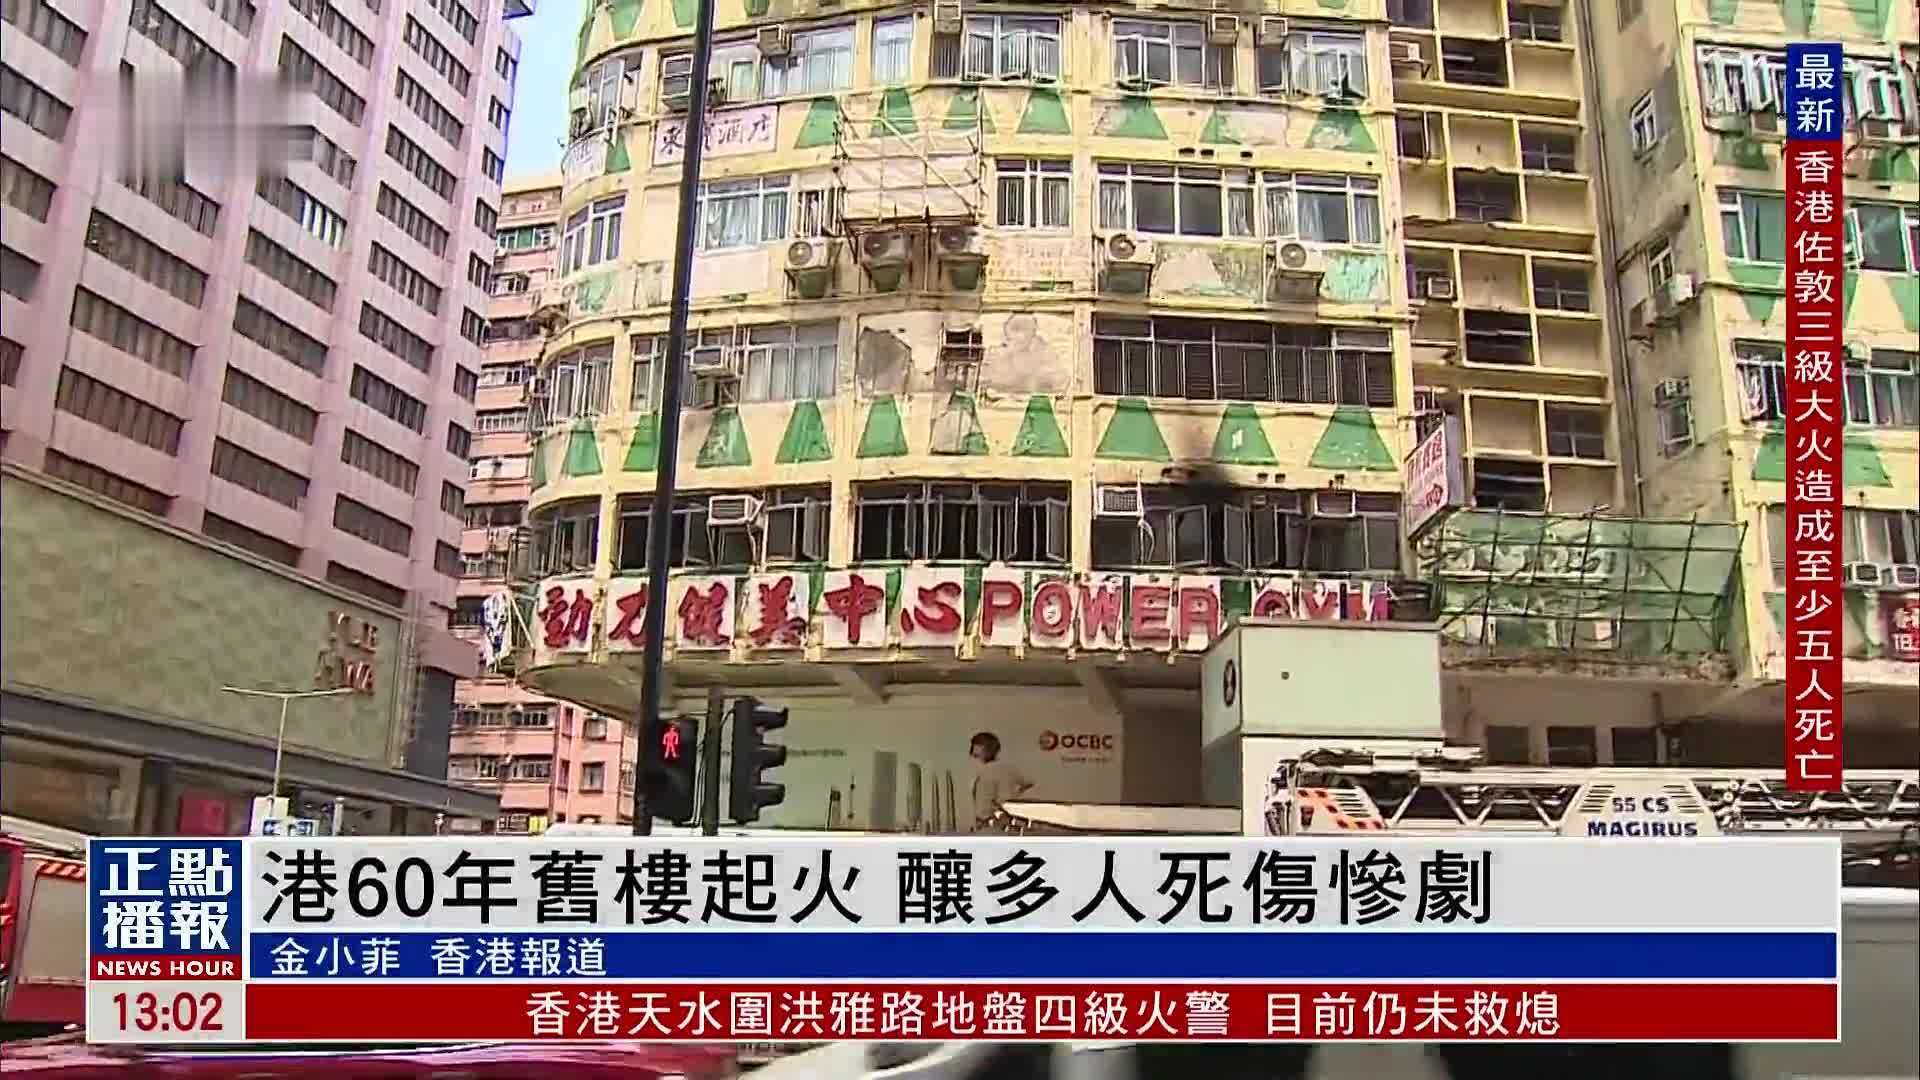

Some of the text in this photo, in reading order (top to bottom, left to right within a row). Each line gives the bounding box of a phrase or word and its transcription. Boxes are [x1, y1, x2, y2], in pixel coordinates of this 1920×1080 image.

[983, 578, 1220, 640] POWER
[1060, 734, 1113, 750] OCBC
[1642, 797, 1670, 813] CS
[1588, 821, 1698, 837] MAGIRUS
